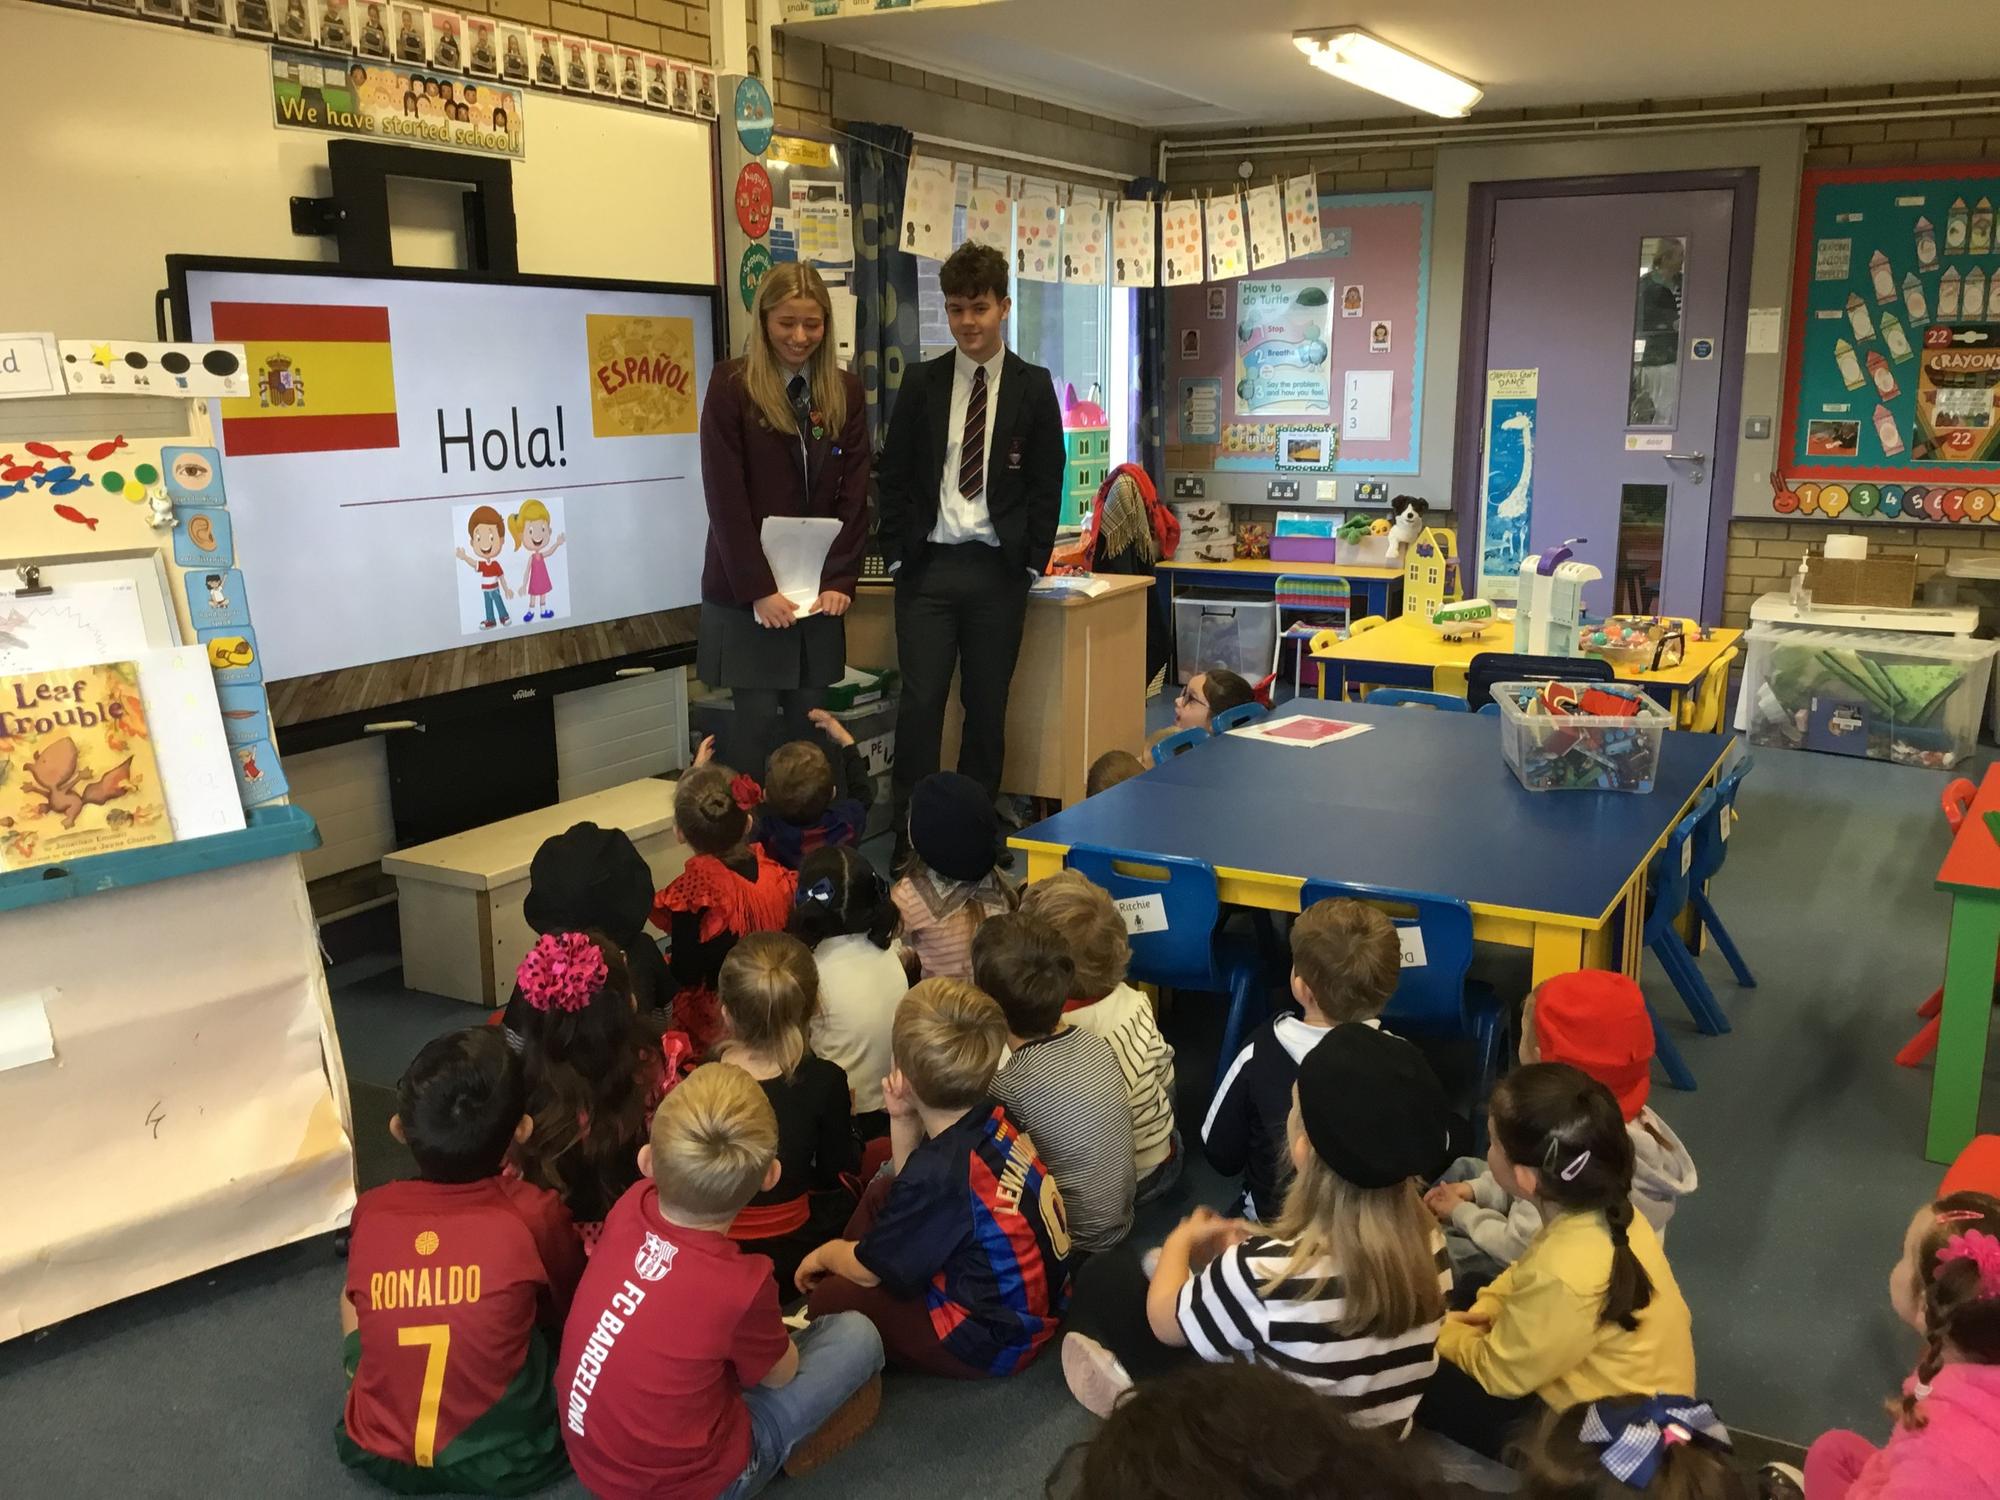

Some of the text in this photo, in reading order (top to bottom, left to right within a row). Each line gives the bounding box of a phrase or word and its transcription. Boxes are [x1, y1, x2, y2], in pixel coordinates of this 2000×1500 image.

[279, 95, 520, 152] We have started school!
[1243, 283, 1282, 293] How to
[1243, 293, 1290, 306] do Turtle
[1268, 325, 1285, 333] Stop
[1928, 330, 1949, 344] 22
[597, 352, 690, 396] ESPAÑOL
[1266, 388, 1280, 396] and
[1281, 388, 1296, 396] how
[1353, 380, 1358, 392] 1
[1350, 399, 1358, 410] 2
[1349, 417, 1357, 429] 3
[437, 405, 567, 474] Hola!
[1239, 431, 1276, 446] Funky
[1951, 432, 1971, 446] 22
[1805, 491, 1812, 504] 1
[1828, 492, 1839, 506] 2
[1859, 491, 1870, 505] 3
[1885, 492, 1897, 505] 4
[1912, 495, 1923, 509] 5
[1953, 496, 1963, 510] 7
[1972, 496, 1984, 511] 8
[13, 680, 87, 710] Leaf
[0, 702, 124, 737] Trouble
[871, 741, 882, 756] PE
[1119, 900, 1151, 912] Ritchie
[371, 1264, 481, 1311] RONALDO
[567, 1279, 646, 1437] FC BARCELONA
[398, 1324, 451, 1468] 7
